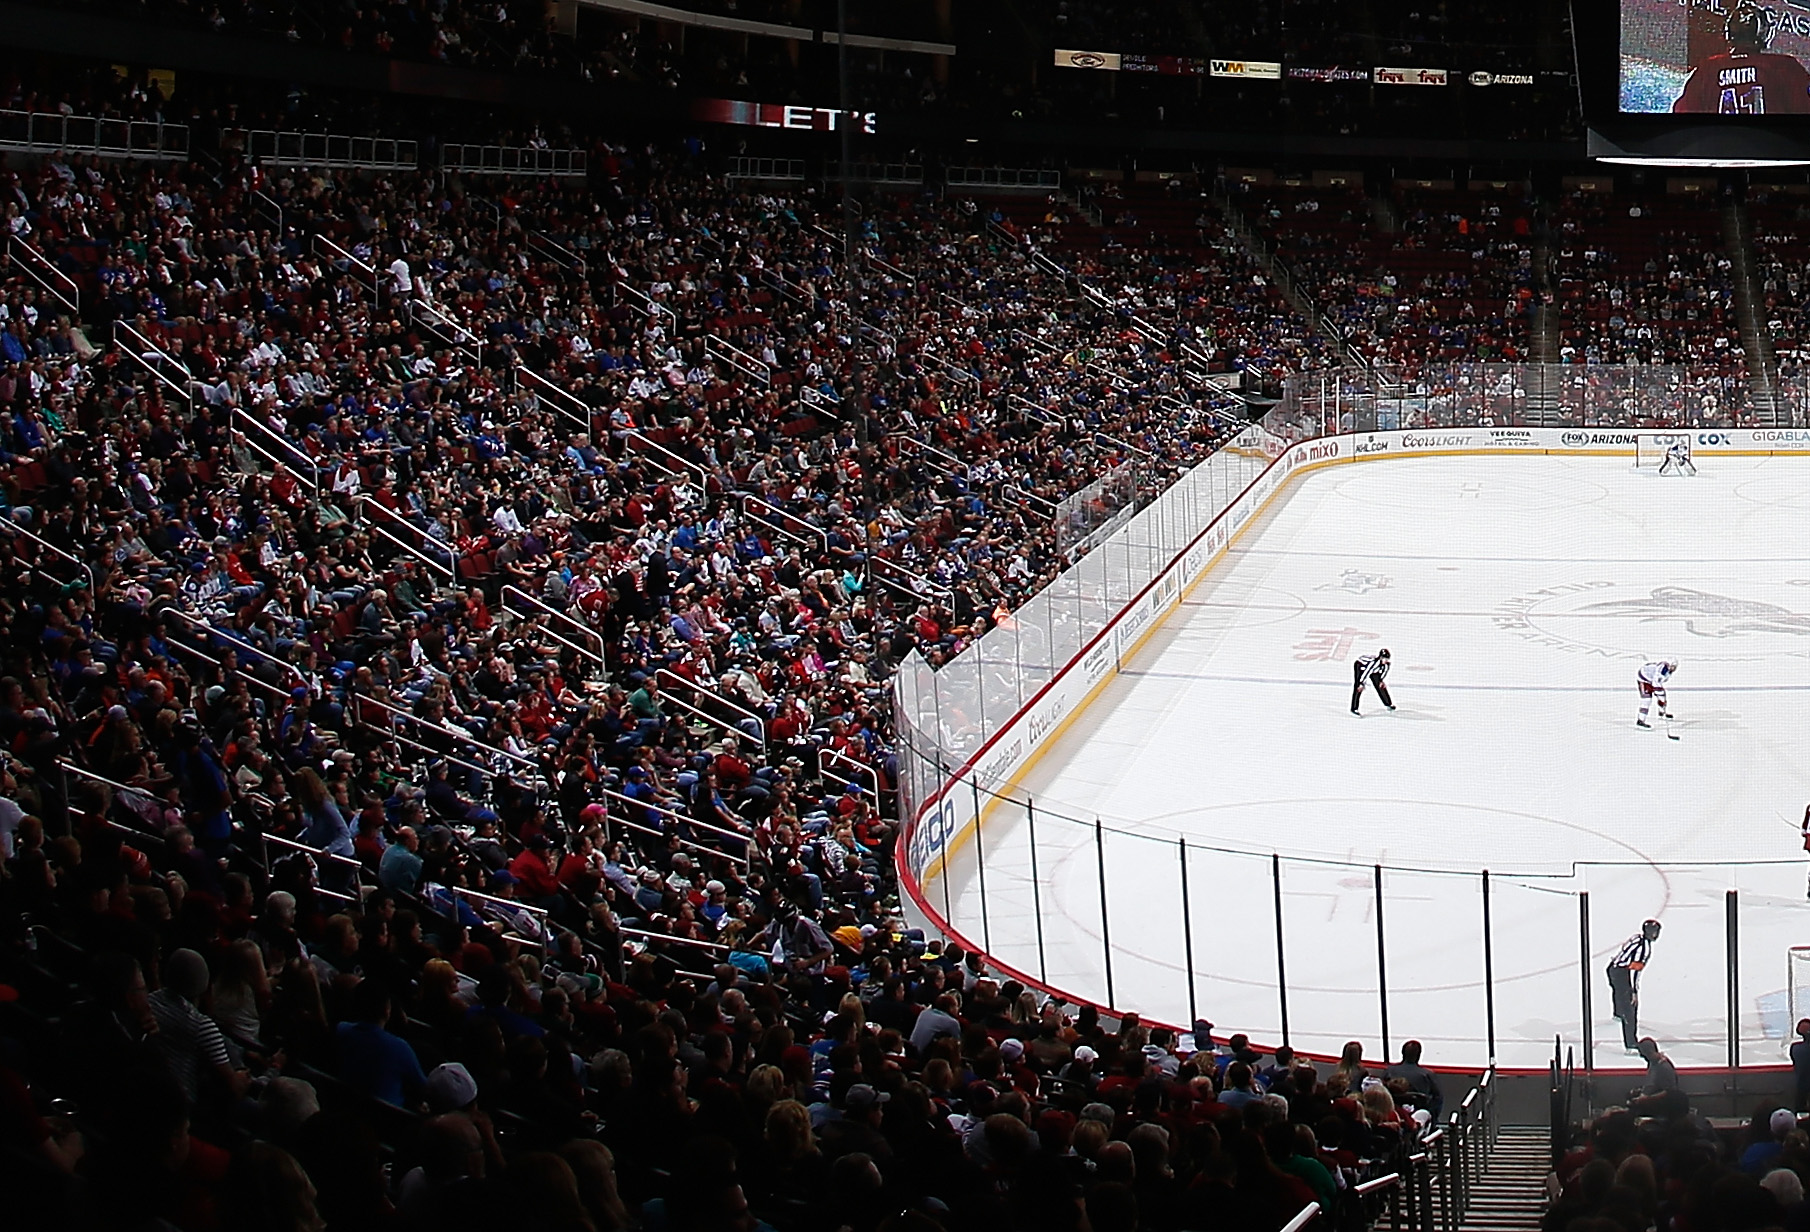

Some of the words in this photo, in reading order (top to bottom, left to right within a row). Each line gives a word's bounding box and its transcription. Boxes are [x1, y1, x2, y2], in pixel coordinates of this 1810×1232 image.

[1493, 75, 1534, 85] ARIZONA
[1718, 67, 1757, 86] SMITH
[1437, 435, 1472, 447] LIGHT
[1590, 434, 1637, 444] ARIZONA
[1698, 433, 1731, 445] COX
